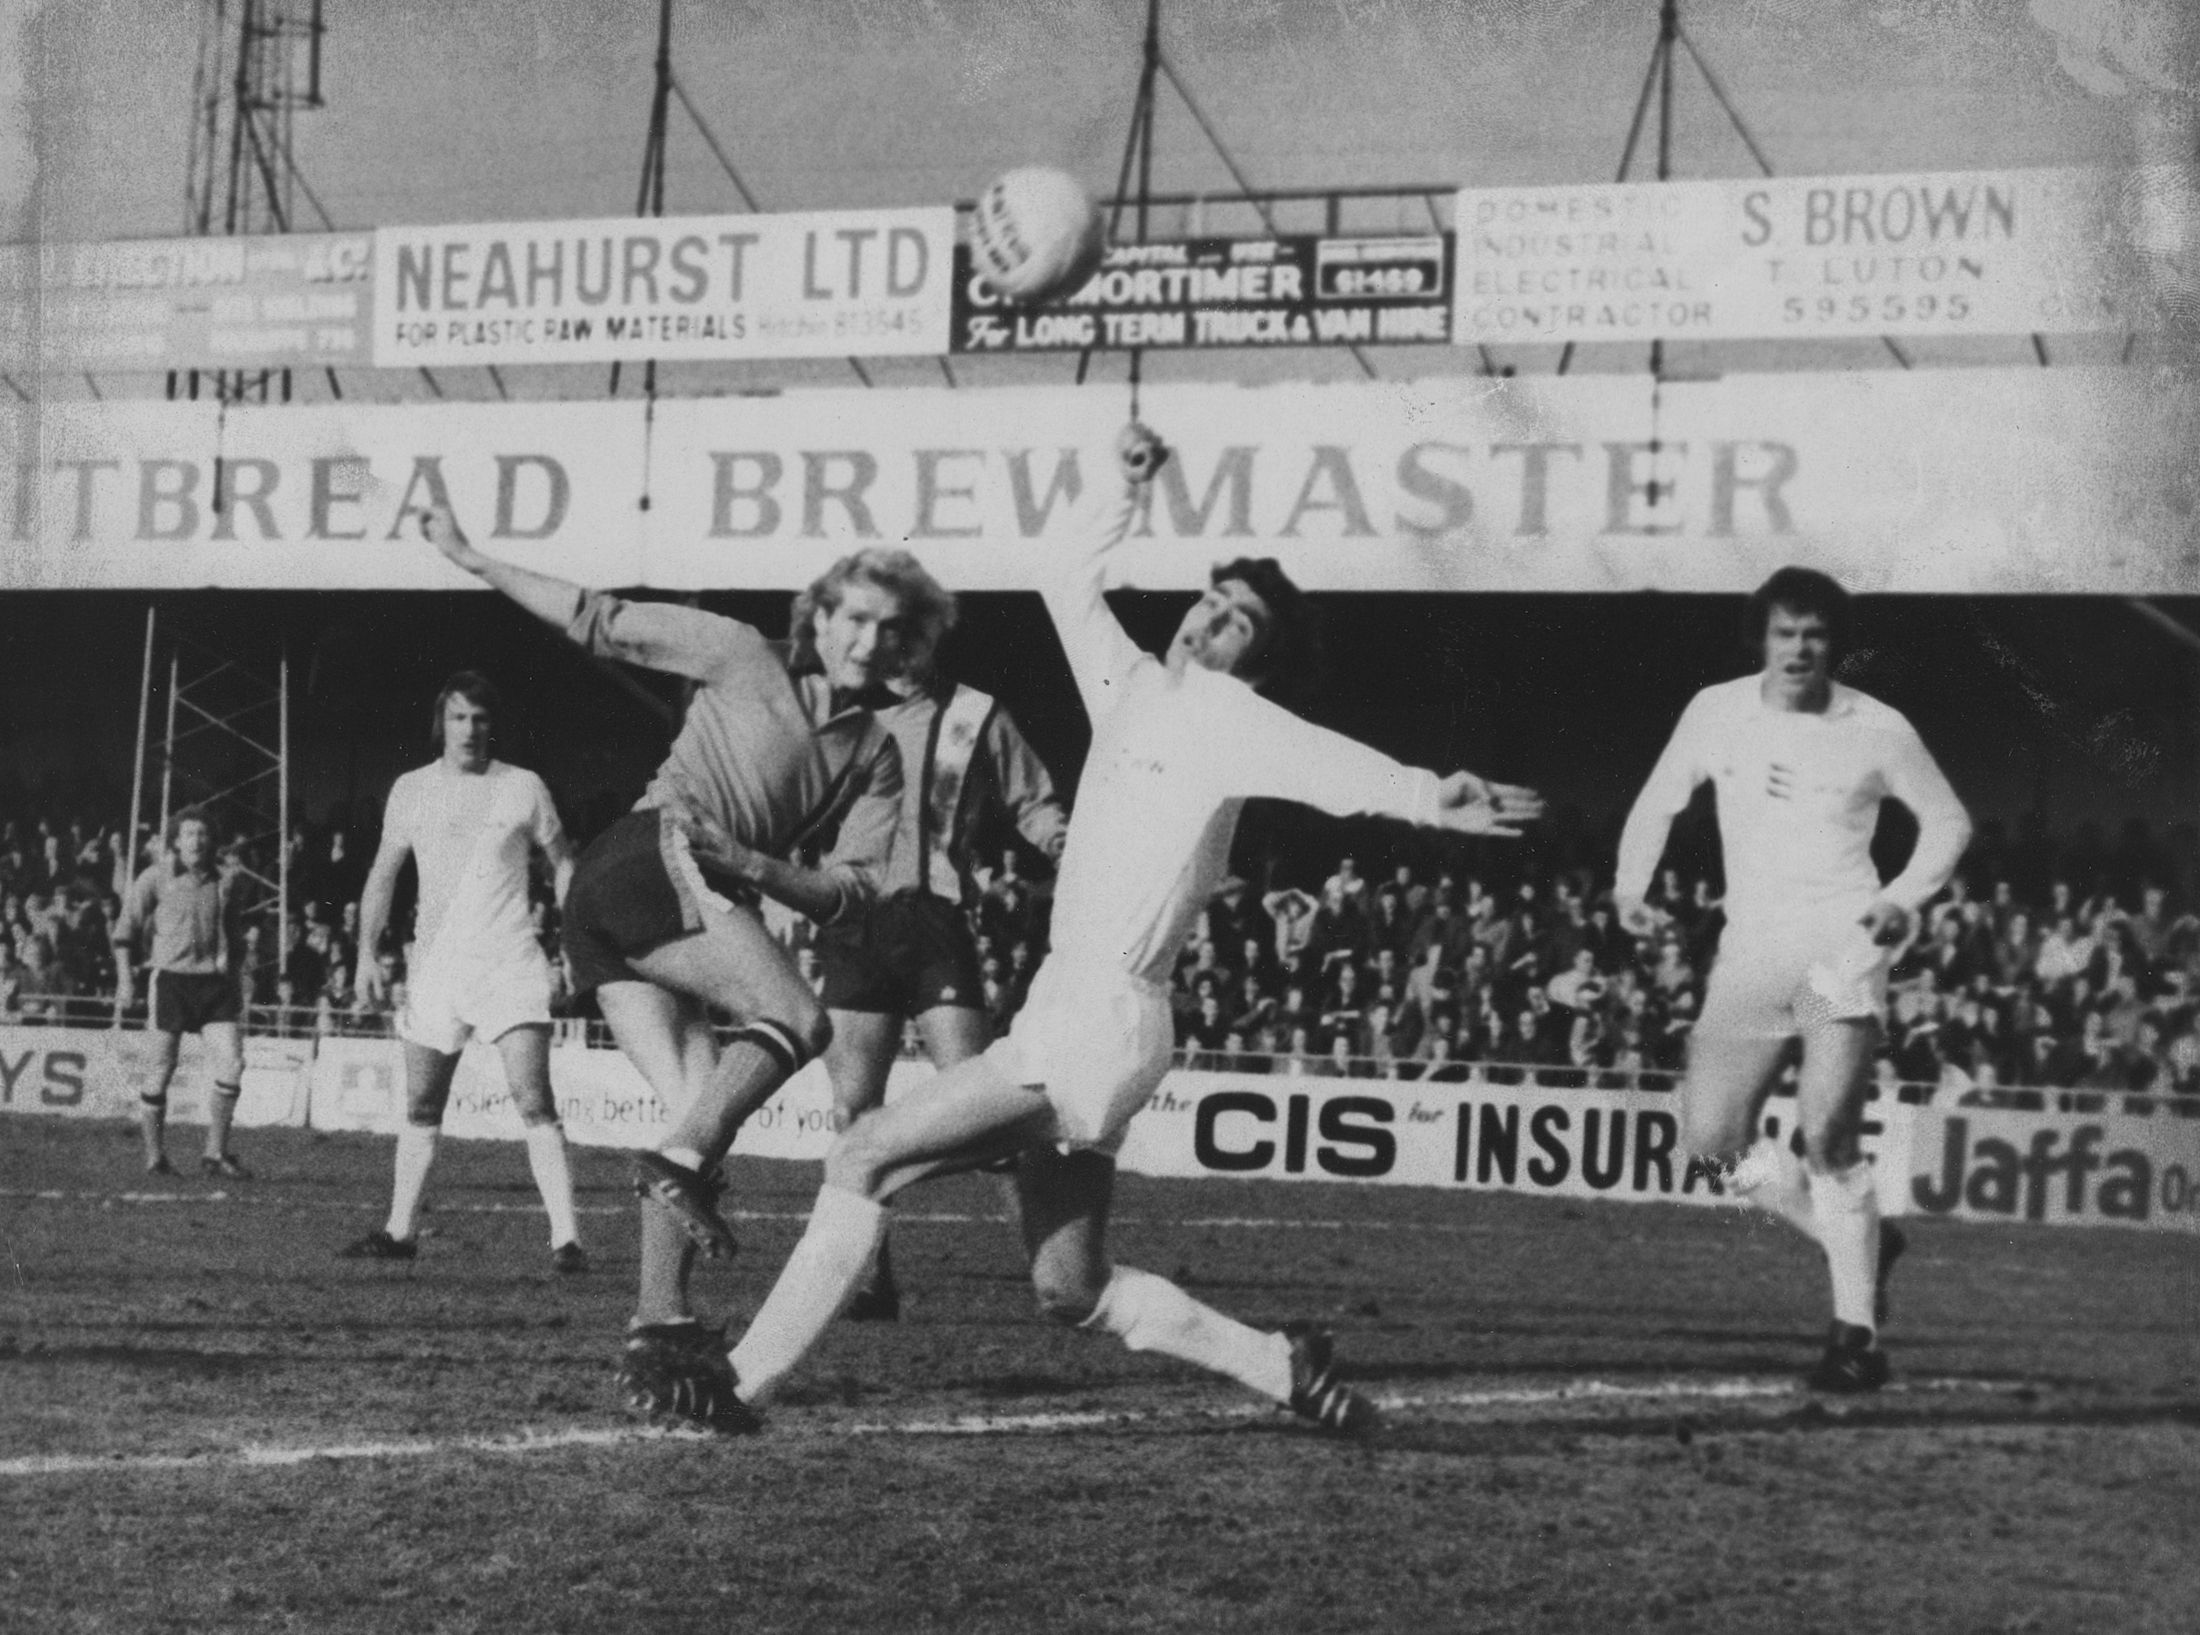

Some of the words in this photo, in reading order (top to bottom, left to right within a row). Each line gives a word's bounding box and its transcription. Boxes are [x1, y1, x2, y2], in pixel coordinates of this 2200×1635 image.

[1804, 185, 2016, 246] BROWN
[396, 232, 760, 312] NEAHURST
[802, 227, 929, 301] LTD
[1473, 267, 1691, 295] ELECTRICAL
[1823, 255, 1984, 285] LUTON
[1014, 313, 1097, 347] LONG
[1102, 311, 1187, 346] TERM
[1312, 306, 1372, 341] VAN
[1472, 302, 1712, 330] CONTRACTOR
[1782, 293, 1970, 324] 595595
[396, 318, 437, 348] FOR
[448, 318, 535, 347] PLASTIC
[544, 316, 593, 342] RAW
[605, 313, 746, 342] MATERIALS
[706, 441, 1799, 539] BREWMASTER
[603, 1091, 670, 1124] bette
[1194, 1090, 1397, 1178] CIS
[1911, 1116, 2152, 1222] Jaffa
